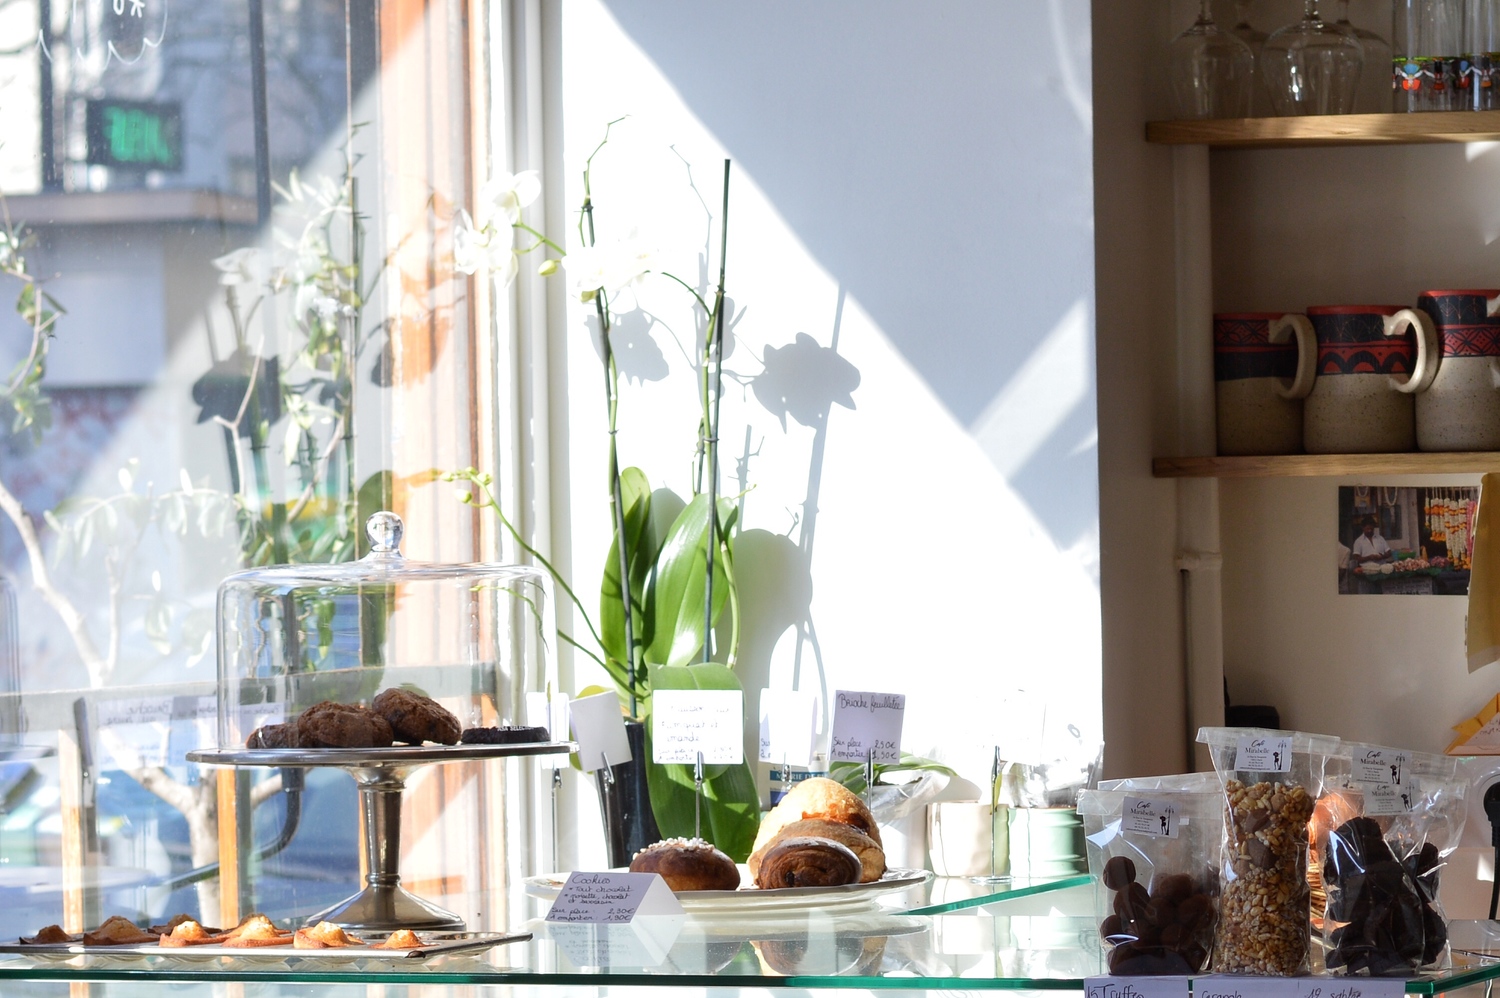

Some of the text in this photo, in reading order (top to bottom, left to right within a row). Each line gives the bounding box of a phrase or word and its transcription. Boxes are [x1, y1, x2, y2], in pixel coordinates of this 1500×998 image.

[838, 693, 869, 709] Brioche
[1360, 758, 1387, 766] Mirabelle
[1130, 808, 1156, 817] Mirabelle
[571, 873, 611, 885] Cookies
